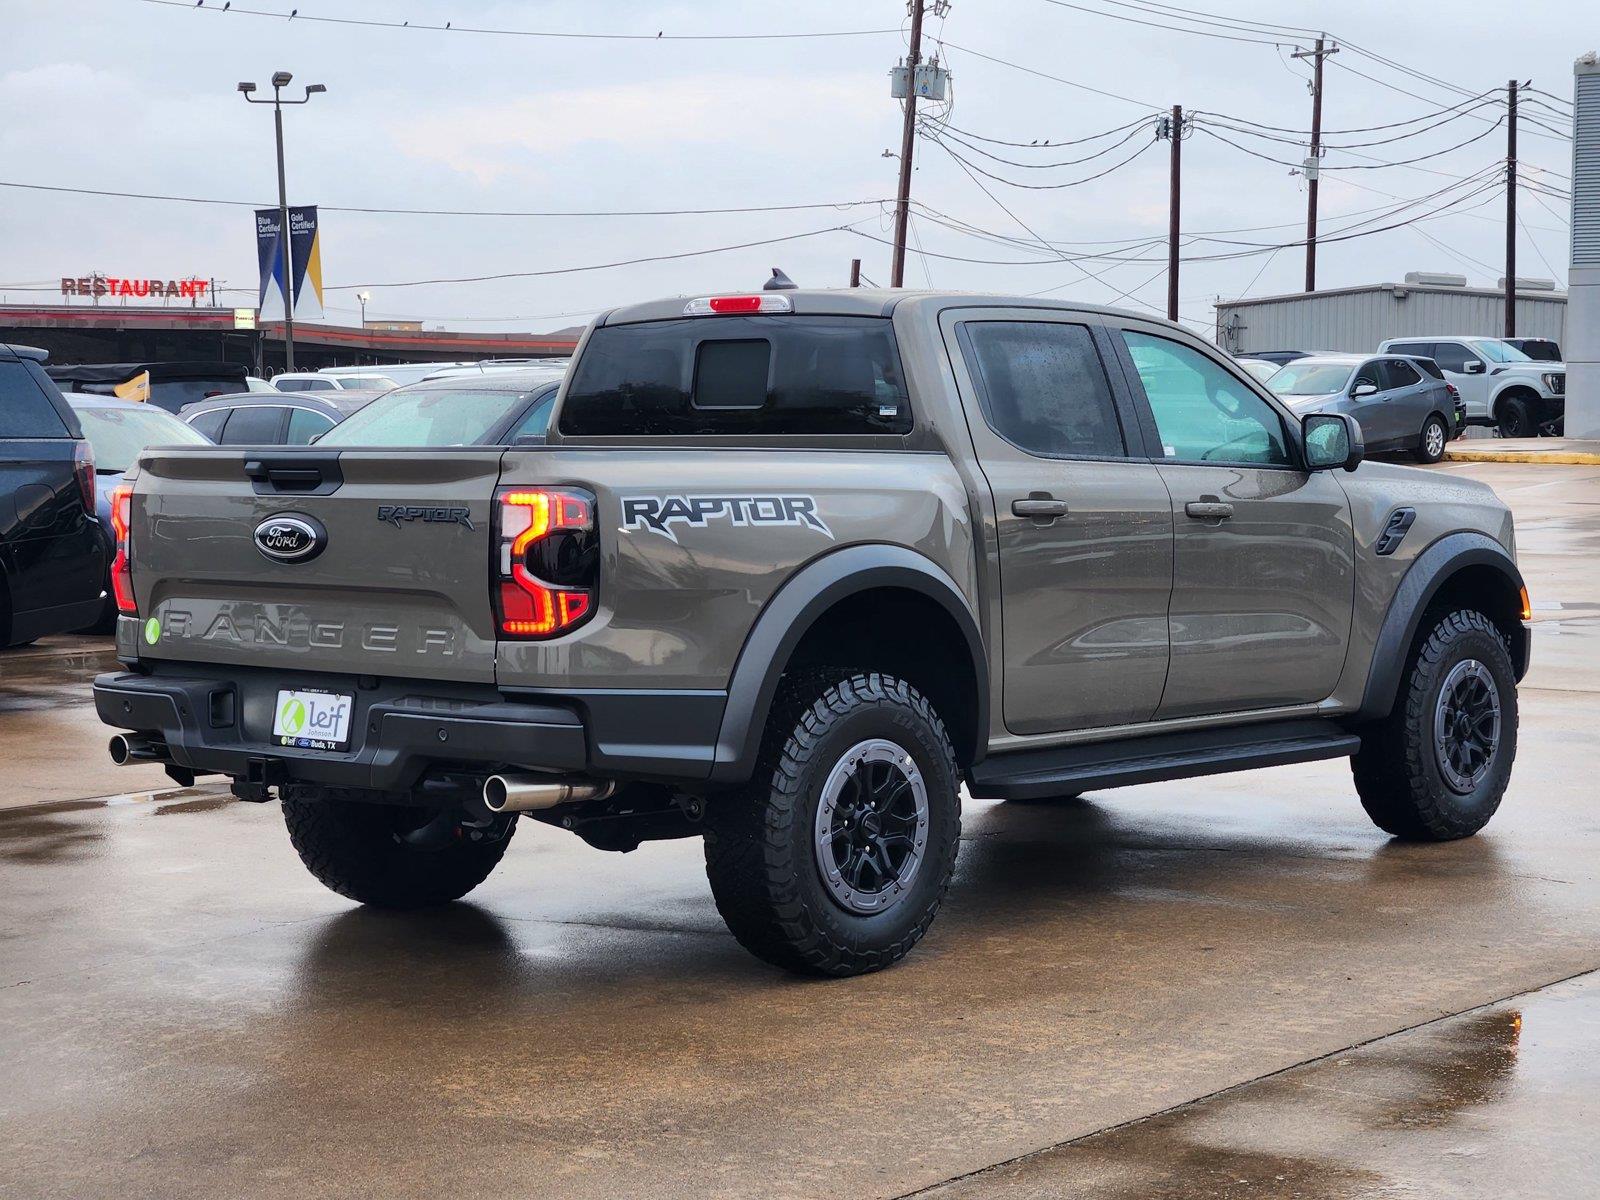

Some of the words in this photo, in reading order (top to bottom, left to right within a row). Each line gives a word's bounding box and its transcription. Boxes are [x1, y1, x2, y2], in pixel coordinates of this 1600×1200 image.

[257, 217, 271, 225] Blue
[291, 213, 304, 221] Gold
[259, 224, 280, 232] Certified
[291, 220, 315, 229] Certified
[61, 277, 208, 298] RESTAURANT
[377, 505, 475, 532] RAPTOR
[620, 494, 836, 544] RAPTOR
[265, 525, 300, 548] Ford
[161, 609, 456, 656] RANGER
[307, 729, 332, 738] Johnson
[328, 741, 336, 749] TX
